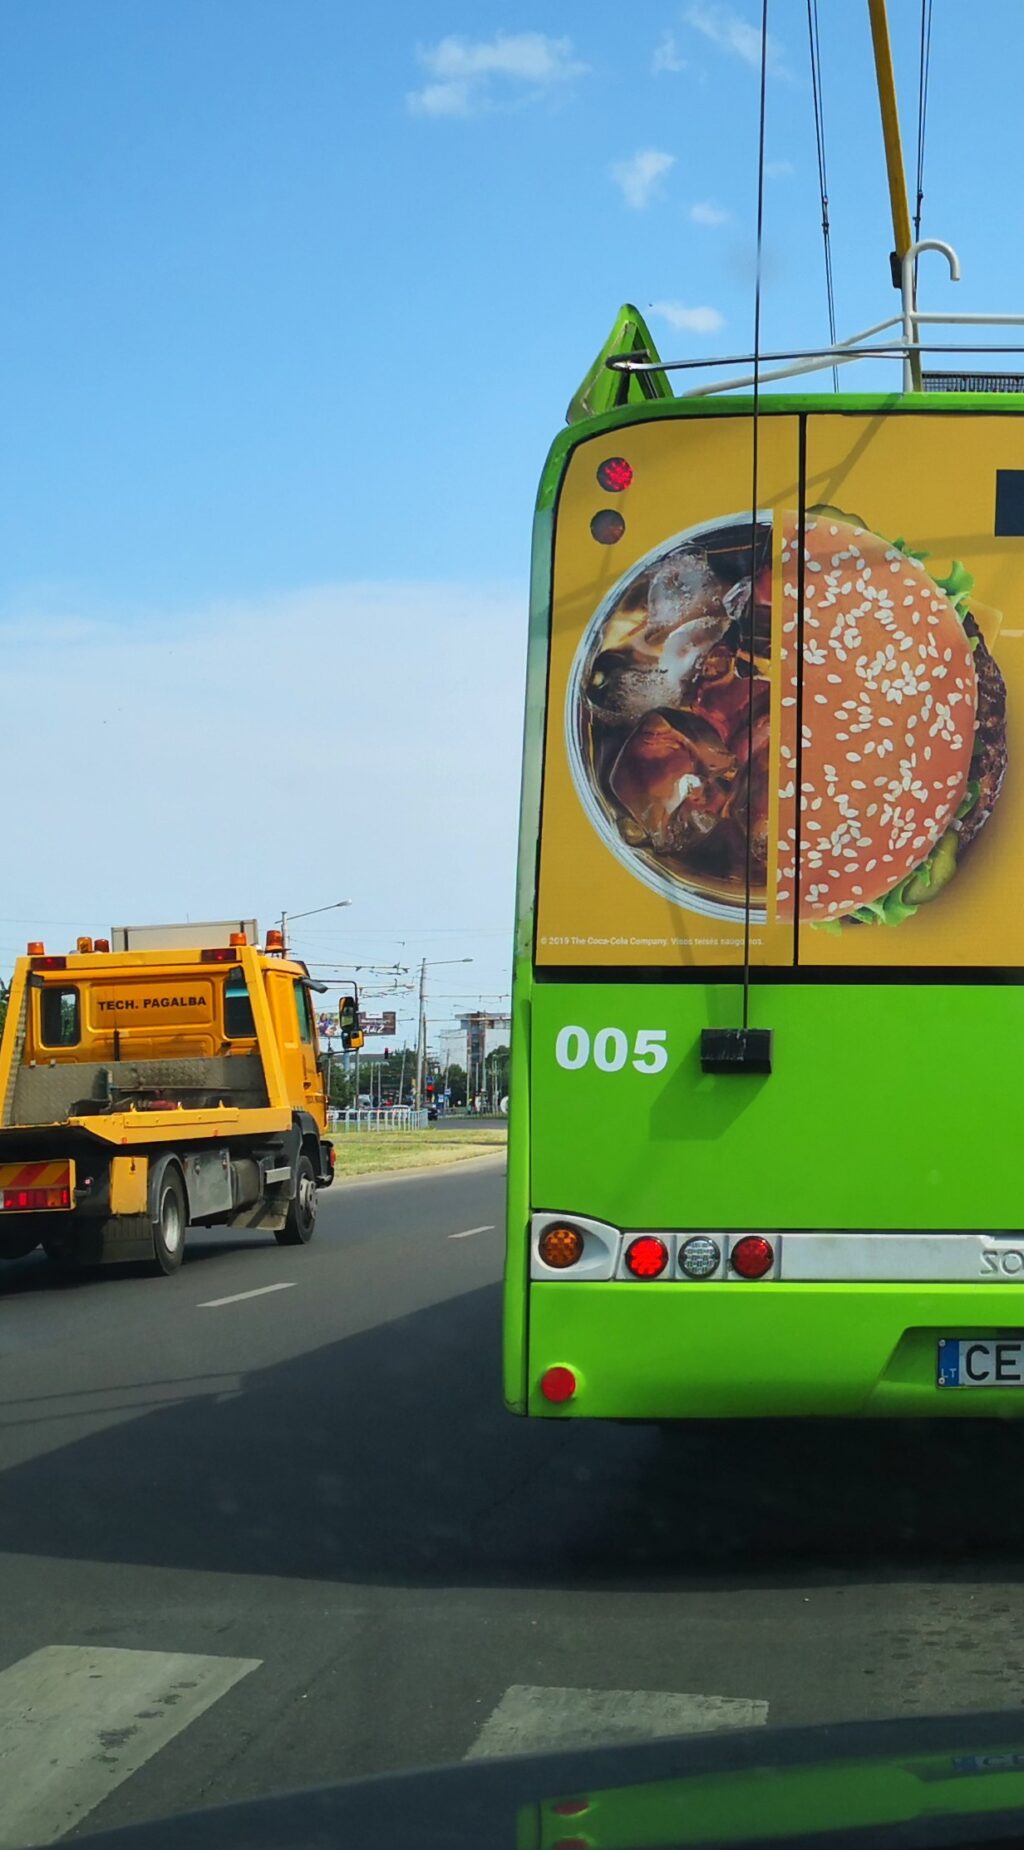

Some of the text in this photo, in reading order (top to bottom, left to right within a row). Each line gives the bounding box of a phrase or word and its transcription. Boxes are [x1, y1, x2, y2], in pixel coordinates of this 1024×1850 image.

[571, 937, 586, 945] The
[587, 937, 629, 945] Coca-Cola
[98, 996, 207, 1011] TECH. PAGALBA
[555, 1025, 668, 1074] 005
